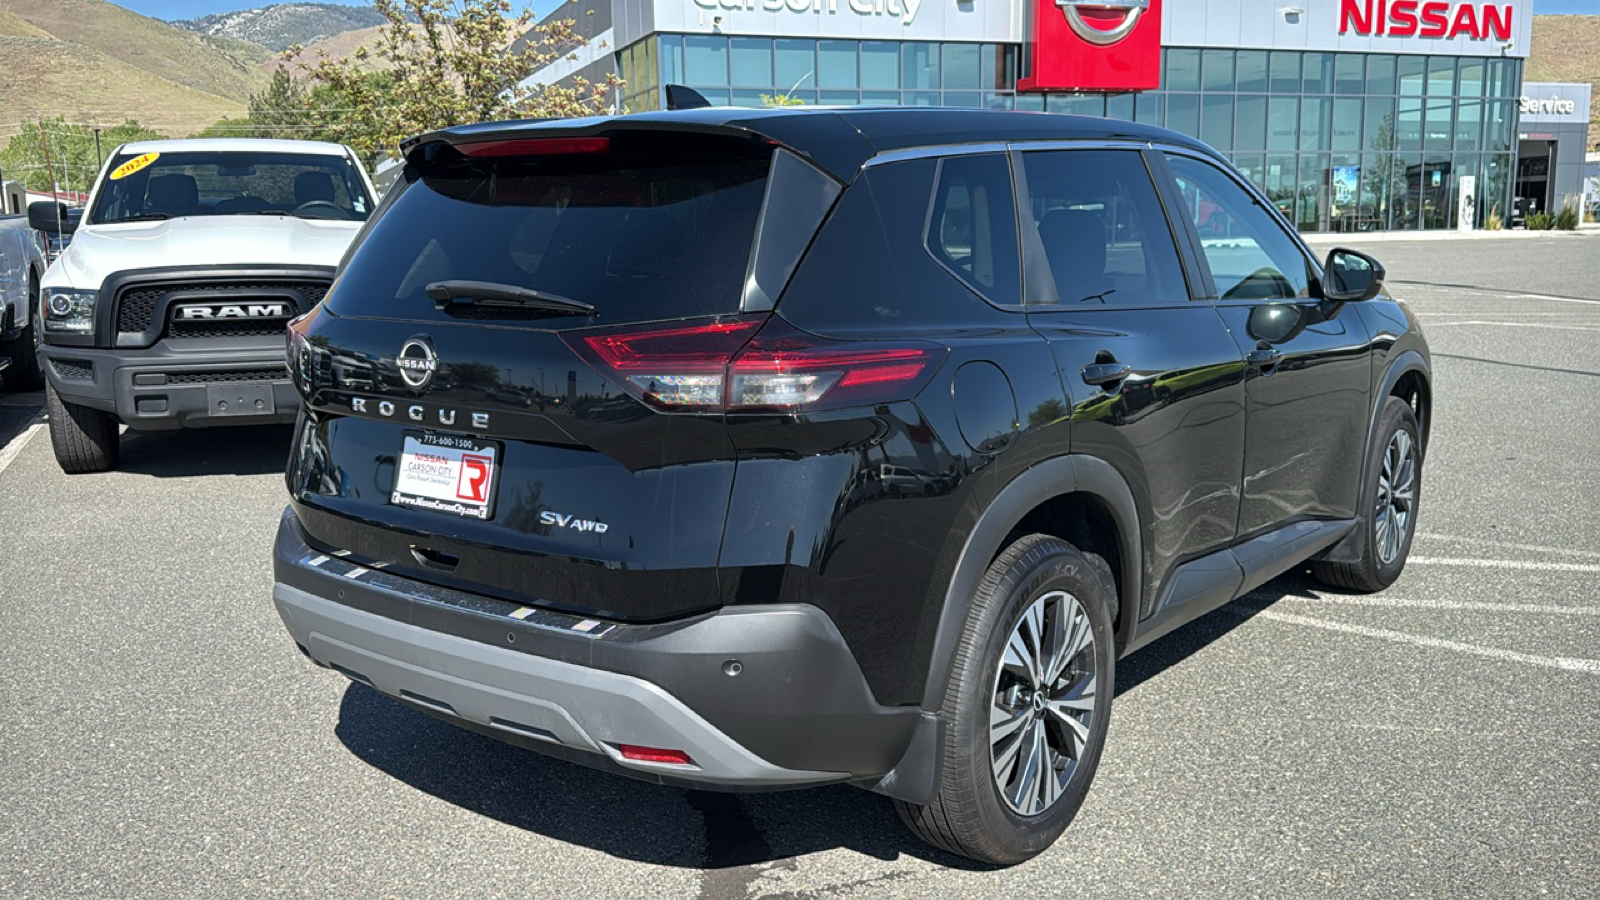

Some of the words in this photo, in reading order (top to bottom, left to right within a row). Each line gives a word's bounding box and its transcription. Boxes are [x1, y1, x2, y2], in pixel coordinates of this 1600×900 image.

[1339, 0, 1513, 41] NISSAN
[1519, 95, 1575, 115] Service
[119, 154, 150, 176] 2024
[183, 305, 284, 319] RAM
[396, 358, 436, 371] NISSAN
[352, 396, 490, 429] ROGUE
[424, 435, 472, 448] 775-600-1500
[415, 452, 449, 464] NISSAN
[408, 461, 437, 474] CARSON
[438, 465, 453, 477] CITY
[540, 510, 575, 527] SV
[569, 519, 609, 534] AWD
